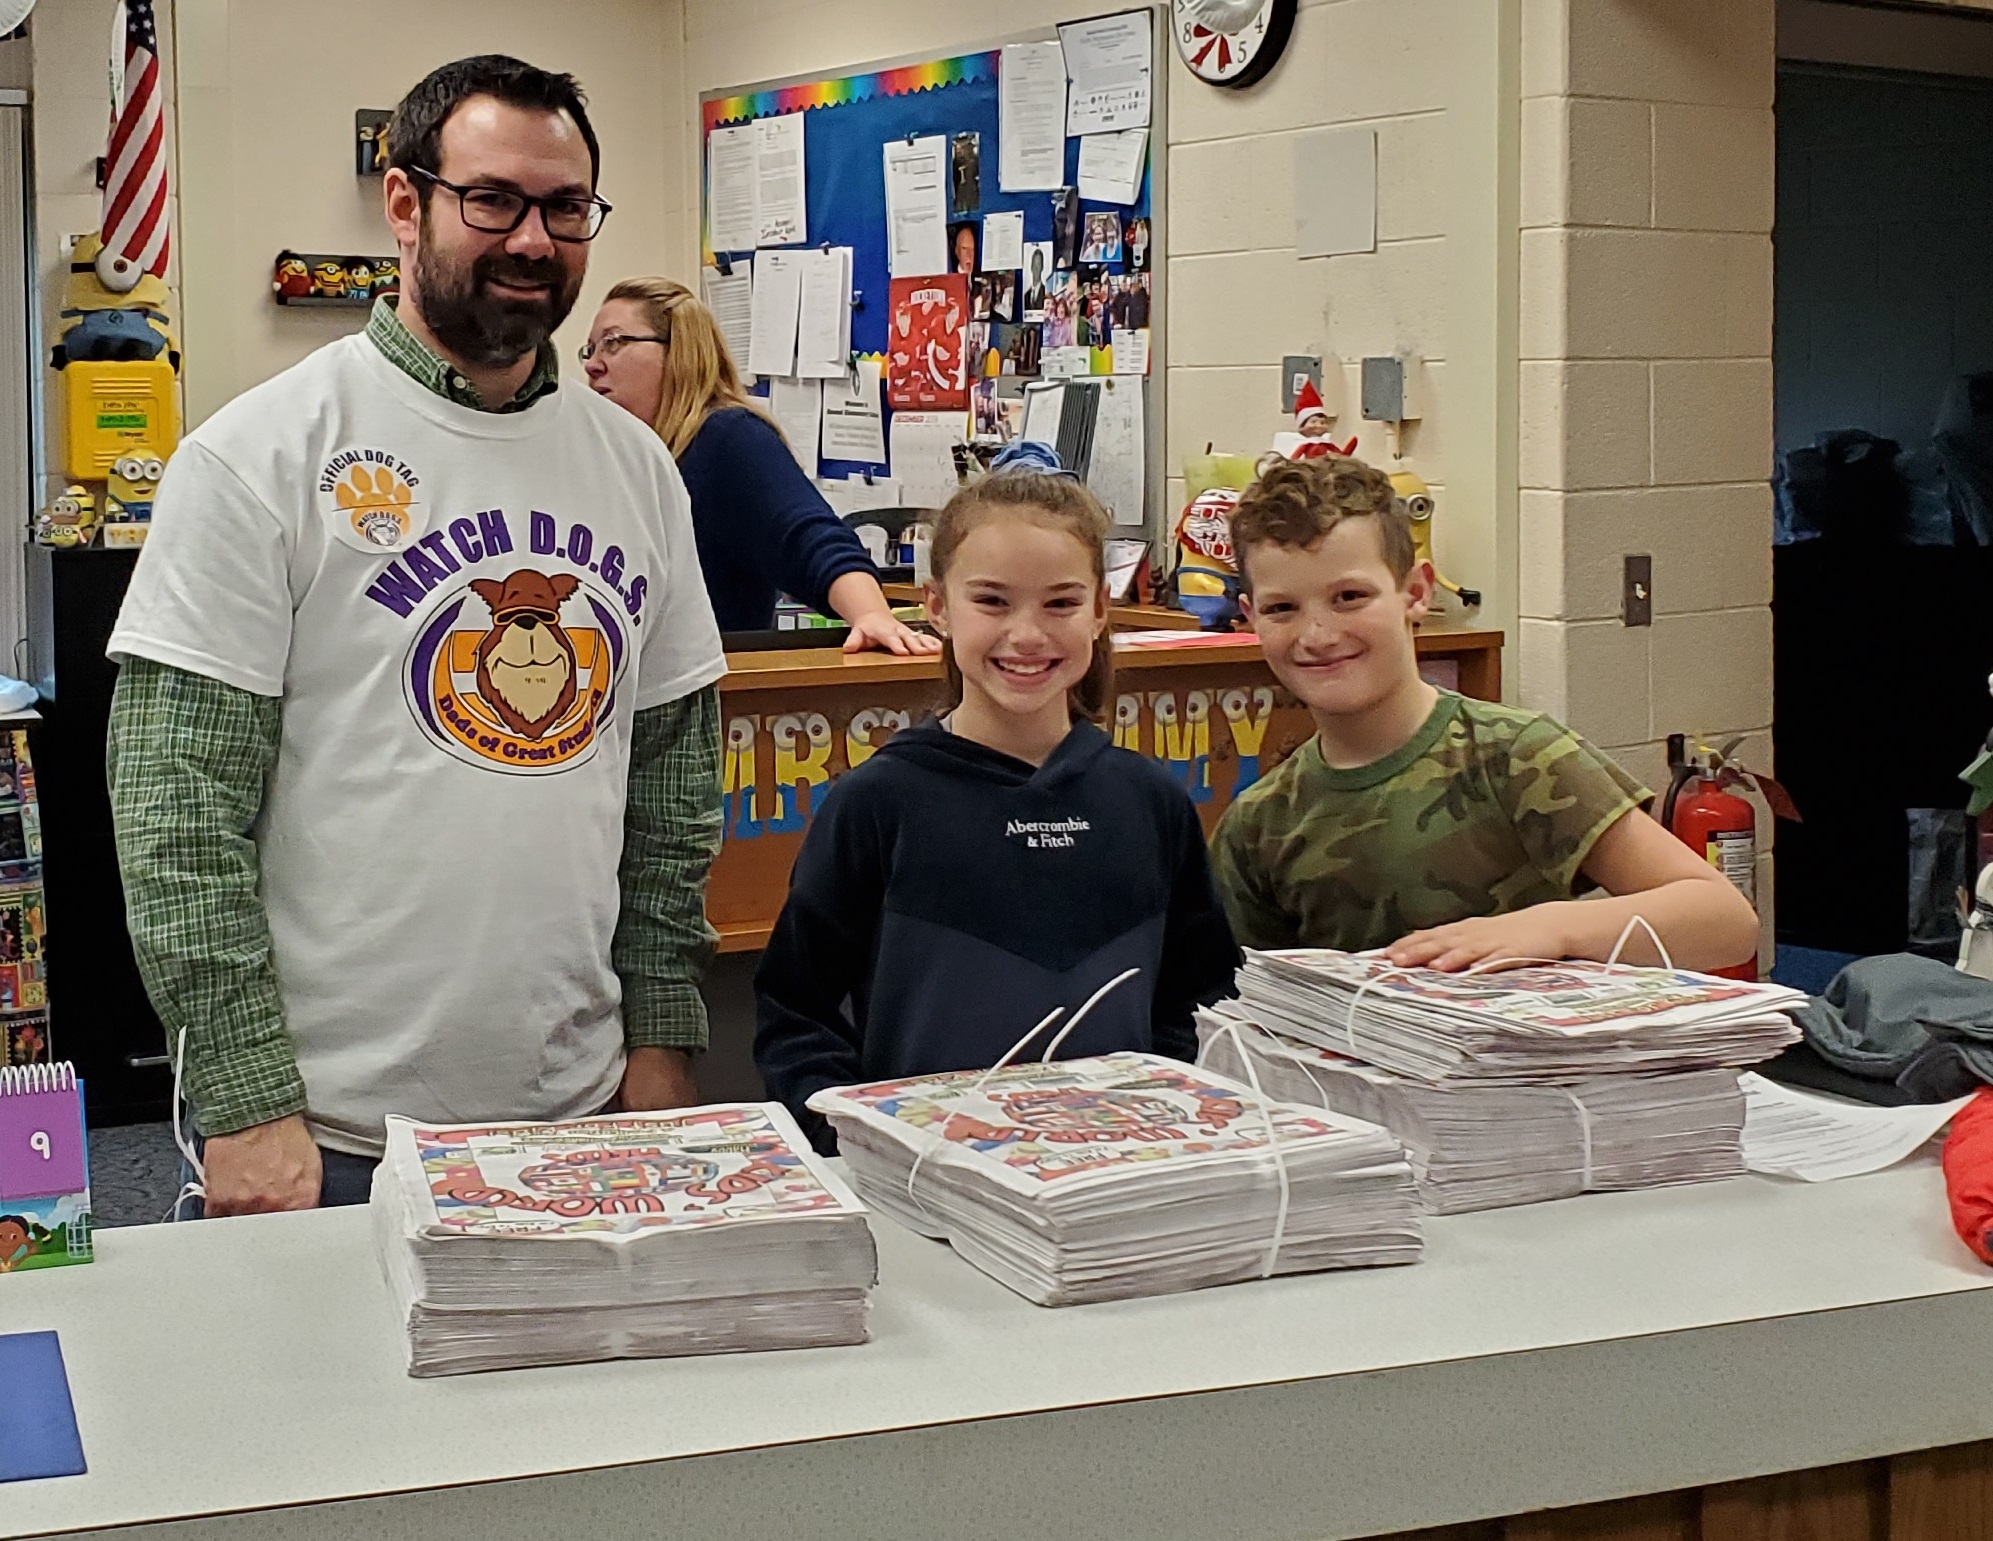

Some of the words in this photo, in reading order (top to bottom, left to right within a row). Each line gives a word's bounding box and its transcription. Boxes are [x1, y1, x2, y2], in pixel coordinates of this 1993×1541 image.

[1183, 22, 1192, 43] 8
[1254, 13, 1264, 34] 4
[1238, 40, 1247, 63] 5
[320, 450, 363, 492] OFFICIAL
[364, 449, 395, 468] DOG
[395, 461, 420, 488] TAG
[357, 511, 378, 528] WATCH
[365, 509, 514, 619] WATCH
[530, 510, 648, 627] D.O.G.S.
[438, 694, 477, 740] Dads
[478, 734, 501, 751] of
[502, 741, 556, 761] Great
[1004, 816, 1091, 836] Abercrombie
[1027, 835, 1039, 848] &
[1040, 832, 1075, 848] Fitch
[30, 1131, 51, 1160] 9
[447, 1185, 666, 1218] WORLD
